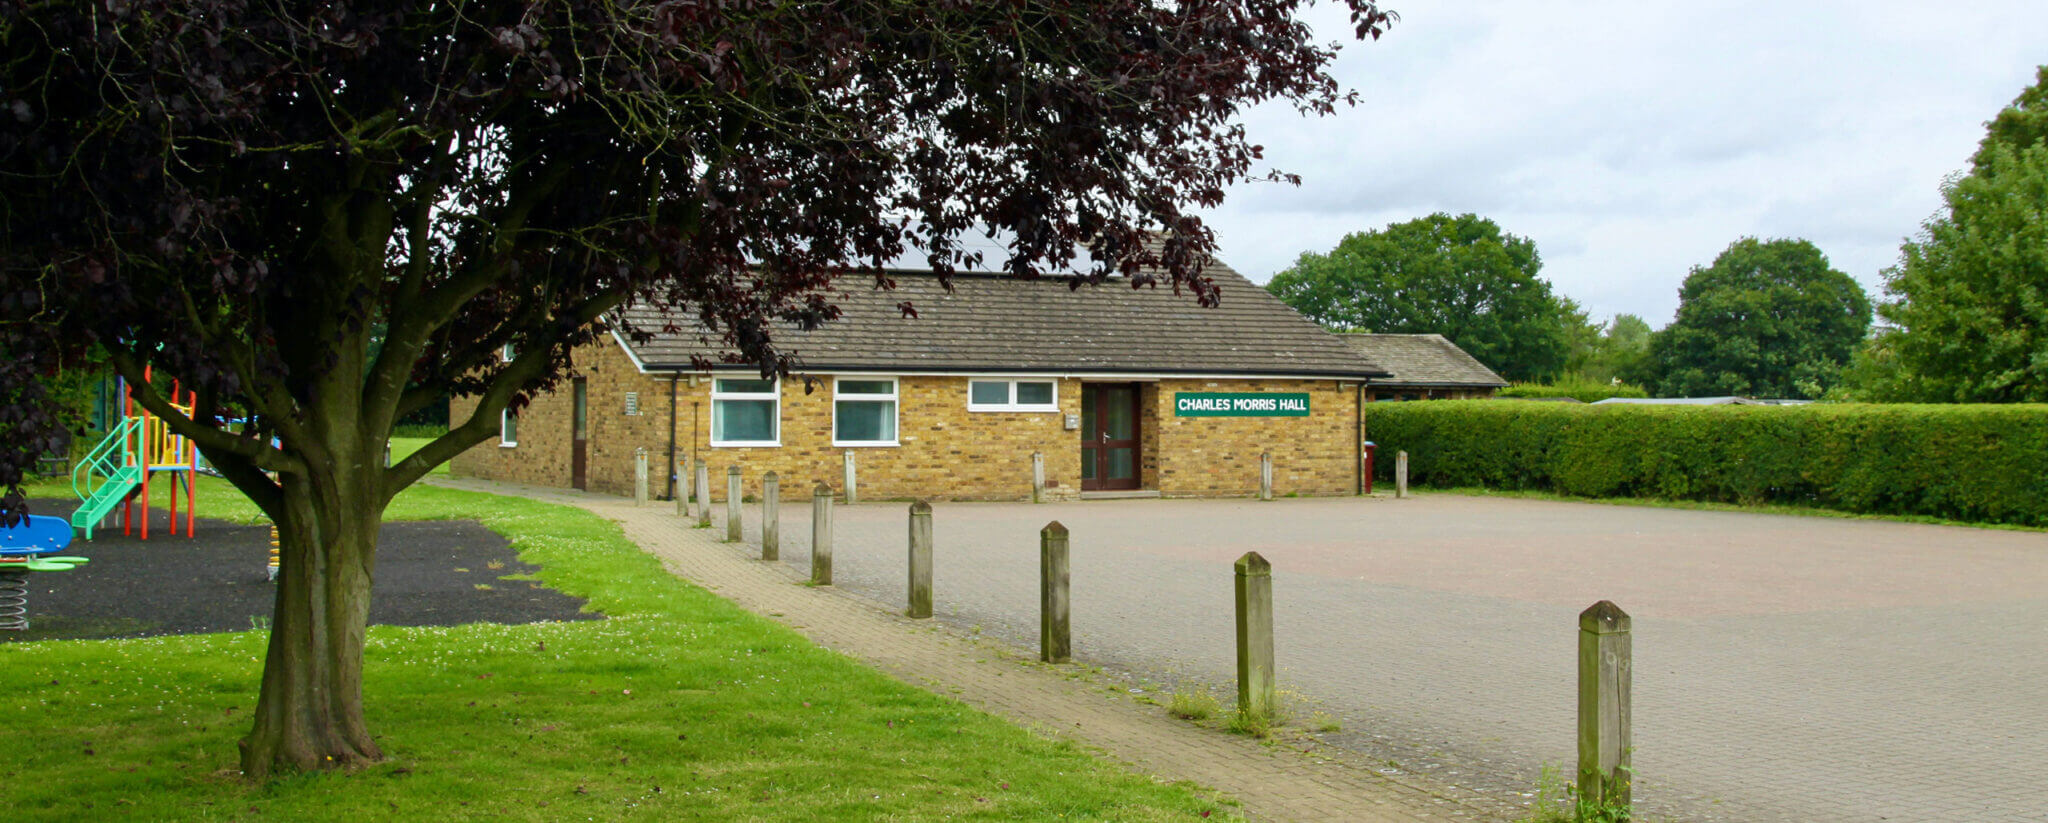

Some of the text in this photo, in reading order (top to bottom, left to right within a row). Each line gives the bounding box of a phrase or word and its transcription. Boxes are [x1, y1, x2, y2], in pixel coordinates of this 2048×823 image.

[1178, 398, 1306, 411] CHARLES MORRIS HALL
